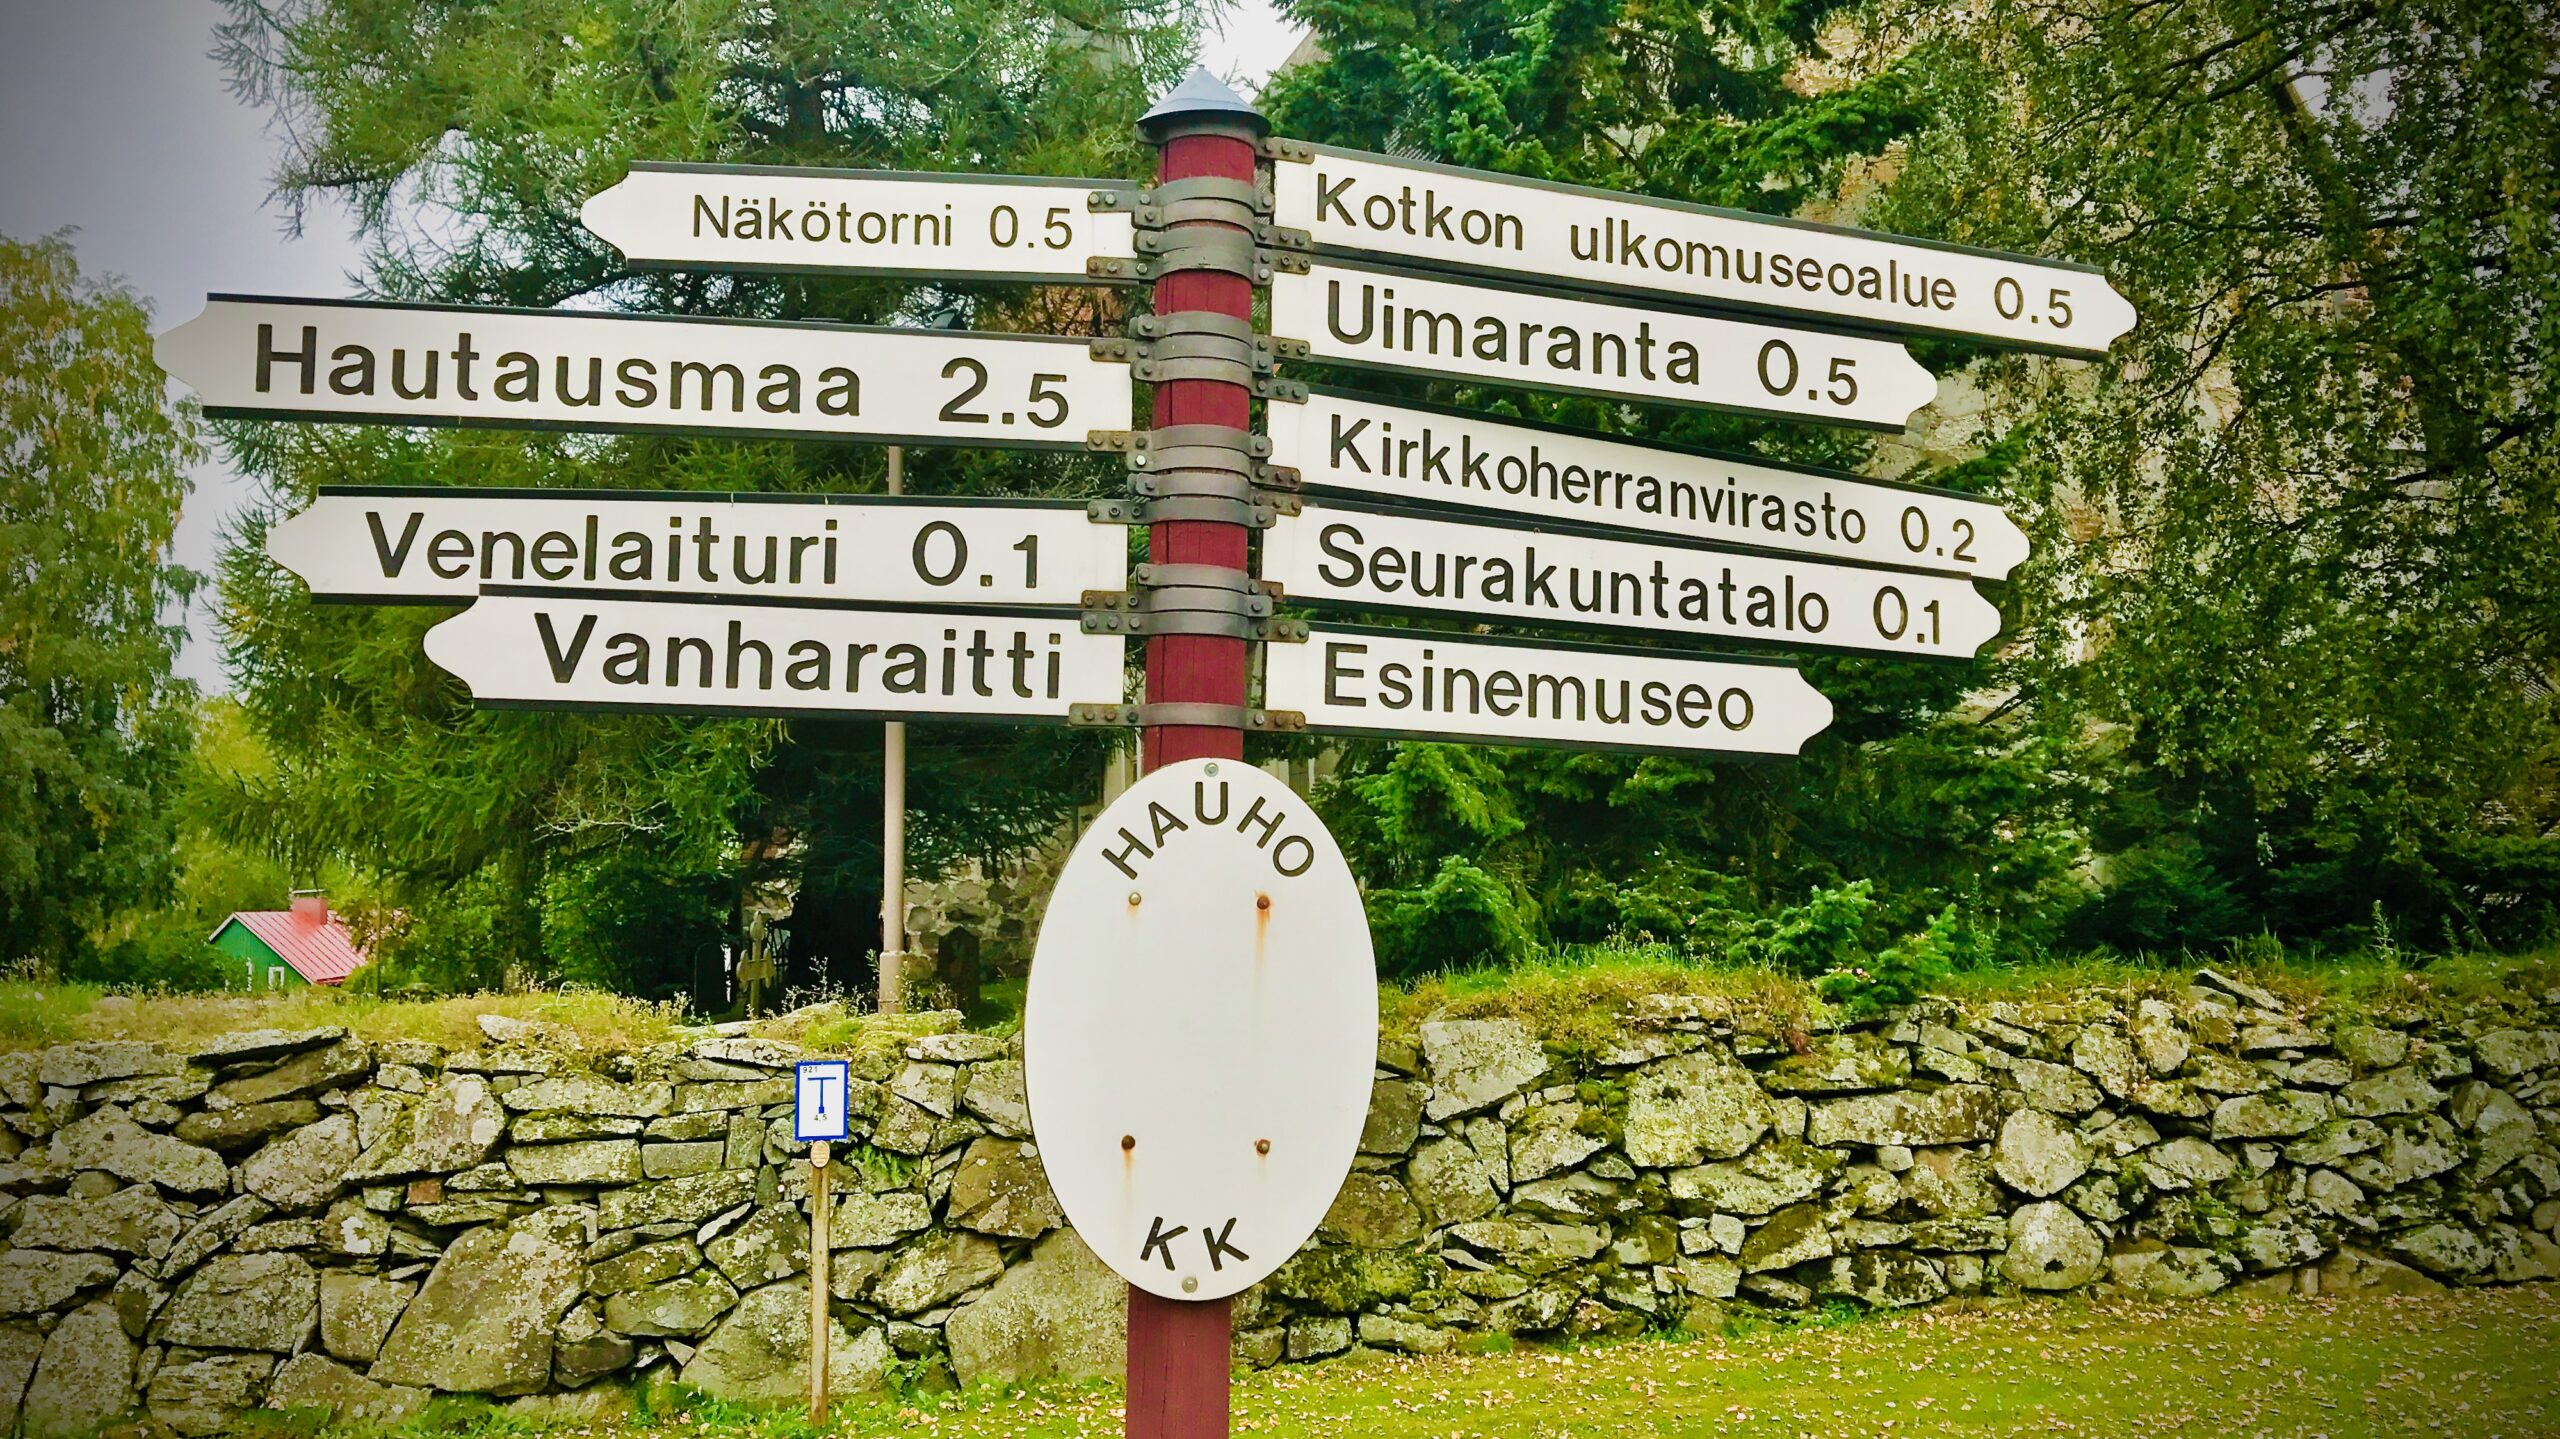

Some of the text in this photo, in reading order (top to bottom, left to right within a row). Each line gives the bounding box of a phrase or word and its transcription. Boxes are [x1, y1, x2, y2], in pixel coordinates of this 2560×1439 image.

[694, 195, 1071, 249] Näkötorni 0.5
[1317, 173, 2071, 328] Kotkon ulkomuseoalue 0.5
[255, 323, 1068, 428] Hautausmaa 2.5
[1327, 279, 1857, 405] Uimaranta 0.5
[1331, 414, 1976, 562] Kirkkoherranvirasto 0.2
[366, 512, 1037, 588] Venelaituri 0.1
[1318, 524, 1939, 644] Seurakuntatalo 0.1
[535, 613, 1060, 698] Vanharaitti
[1325, 642, 1754, 730] Esinemuseo
[1101, 781, 1315, 880] HAUHO
